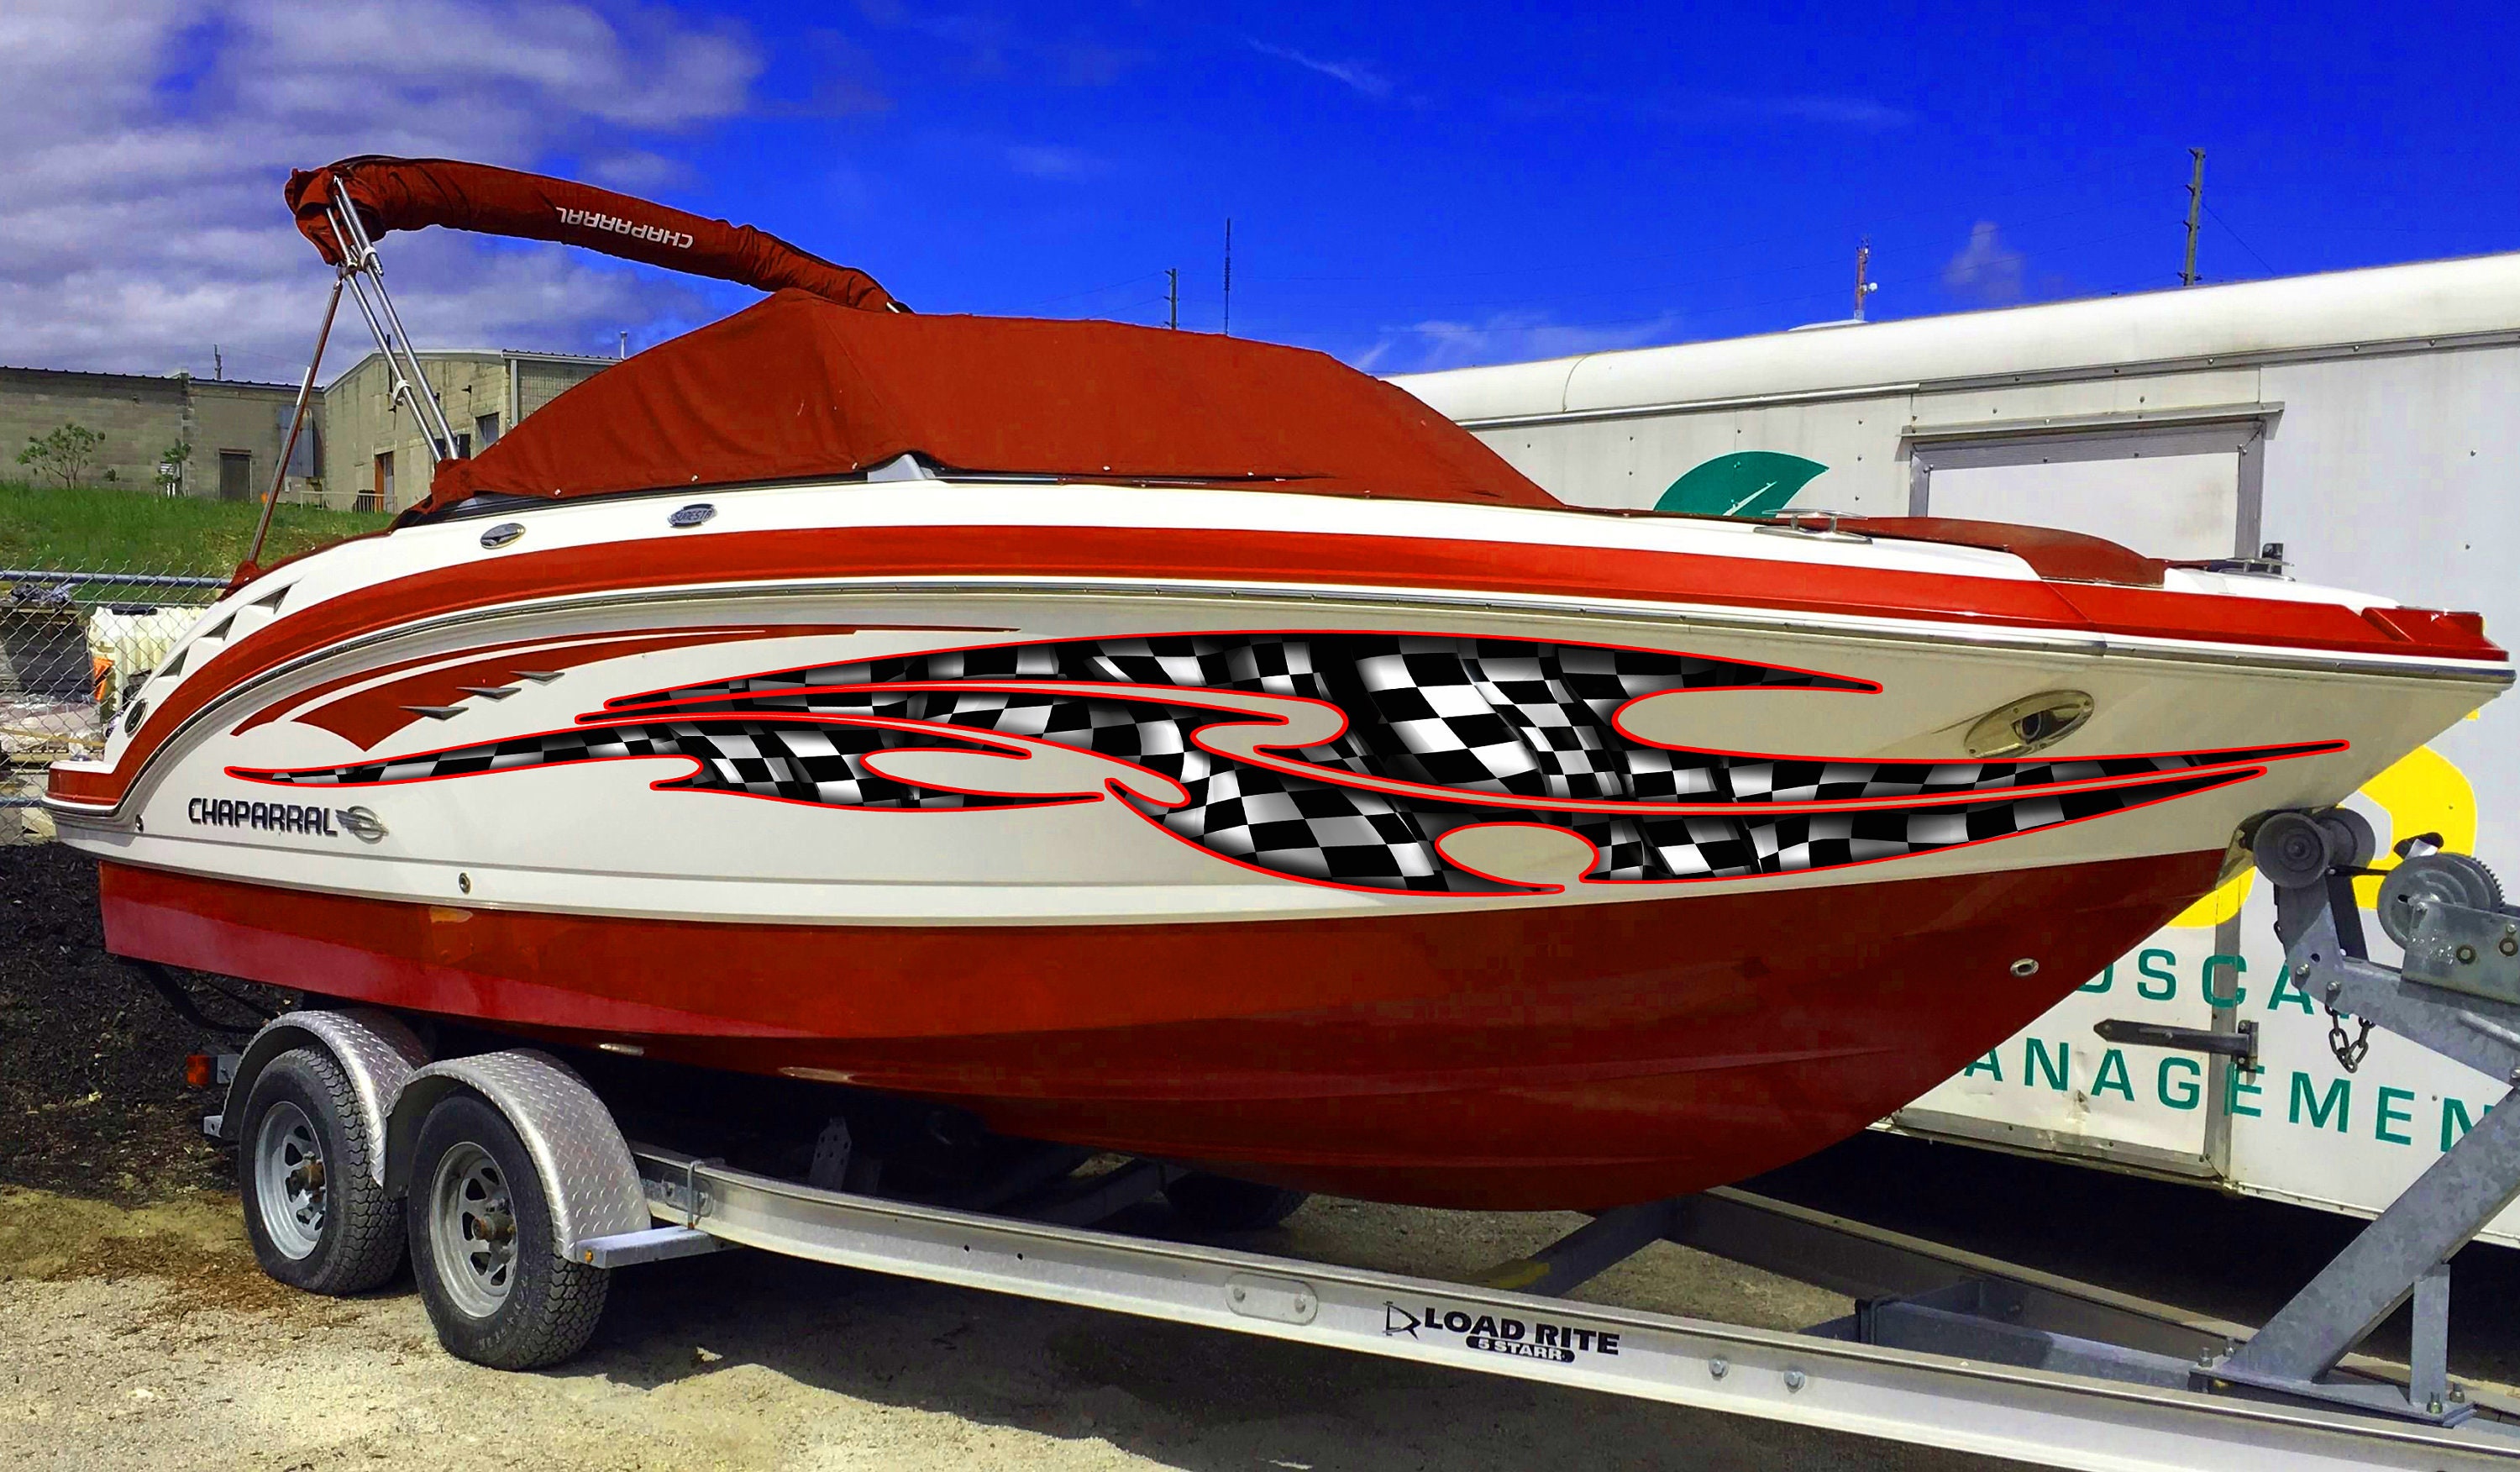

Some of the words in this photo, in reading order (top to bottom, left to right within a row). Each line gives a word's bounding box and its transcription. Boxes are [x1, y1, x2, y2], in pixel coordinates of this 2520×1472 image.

[554, 206, 694, 250] CHAPARRAL
[187, 797, 339, 838] CHAPARRAL
[1424, 1306, 1526, 1342] LOAD
[1534, 1322, 1621, 1356] RITE
[1478, 1338, 1491, 1350] 5
[1494, 1340, 1563, 1362] STARR
